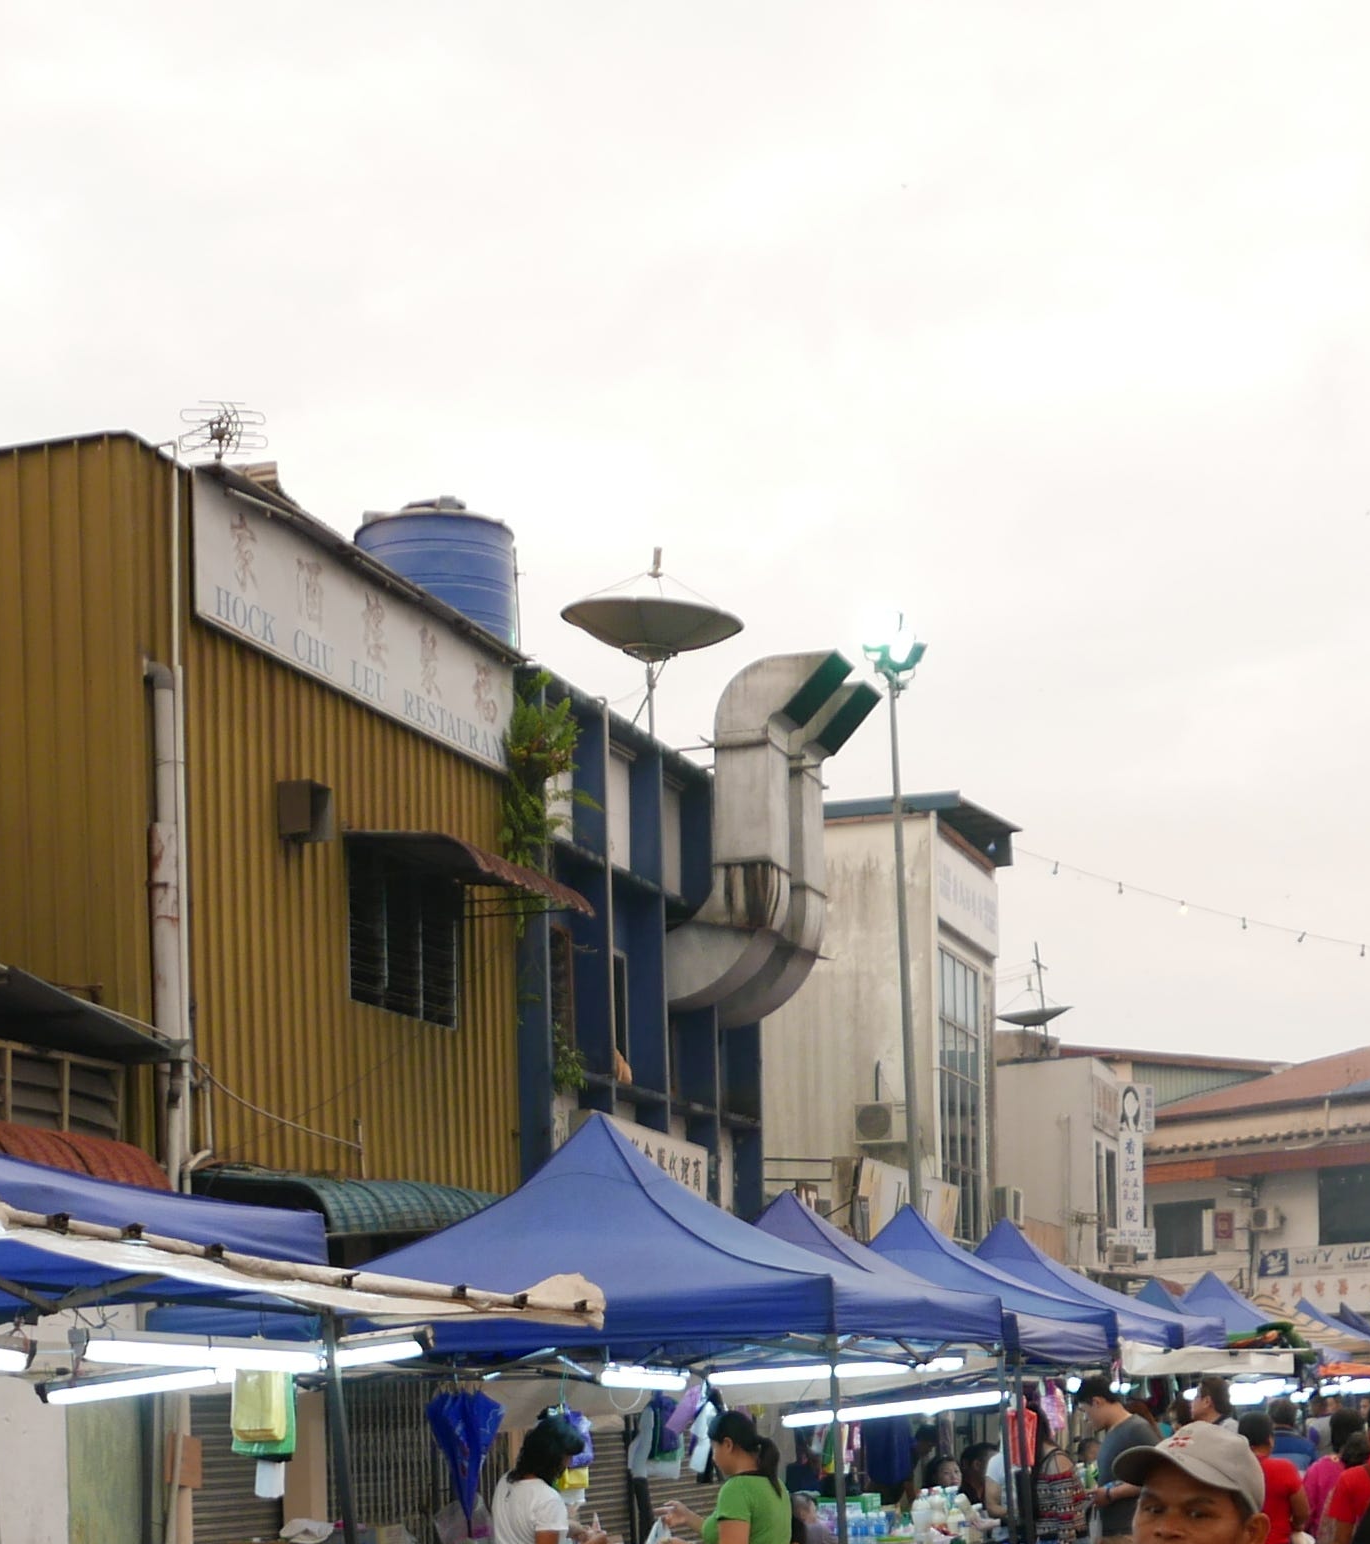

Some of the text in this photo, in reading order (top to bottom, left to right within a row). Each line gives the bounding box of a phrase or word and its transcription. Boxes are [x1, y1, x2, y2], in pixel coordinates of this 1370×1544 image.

[215, 585, 277, 646] HOCK
[294, 628, 334, 676] CHU
[350, 660, 387, 702] LEU
